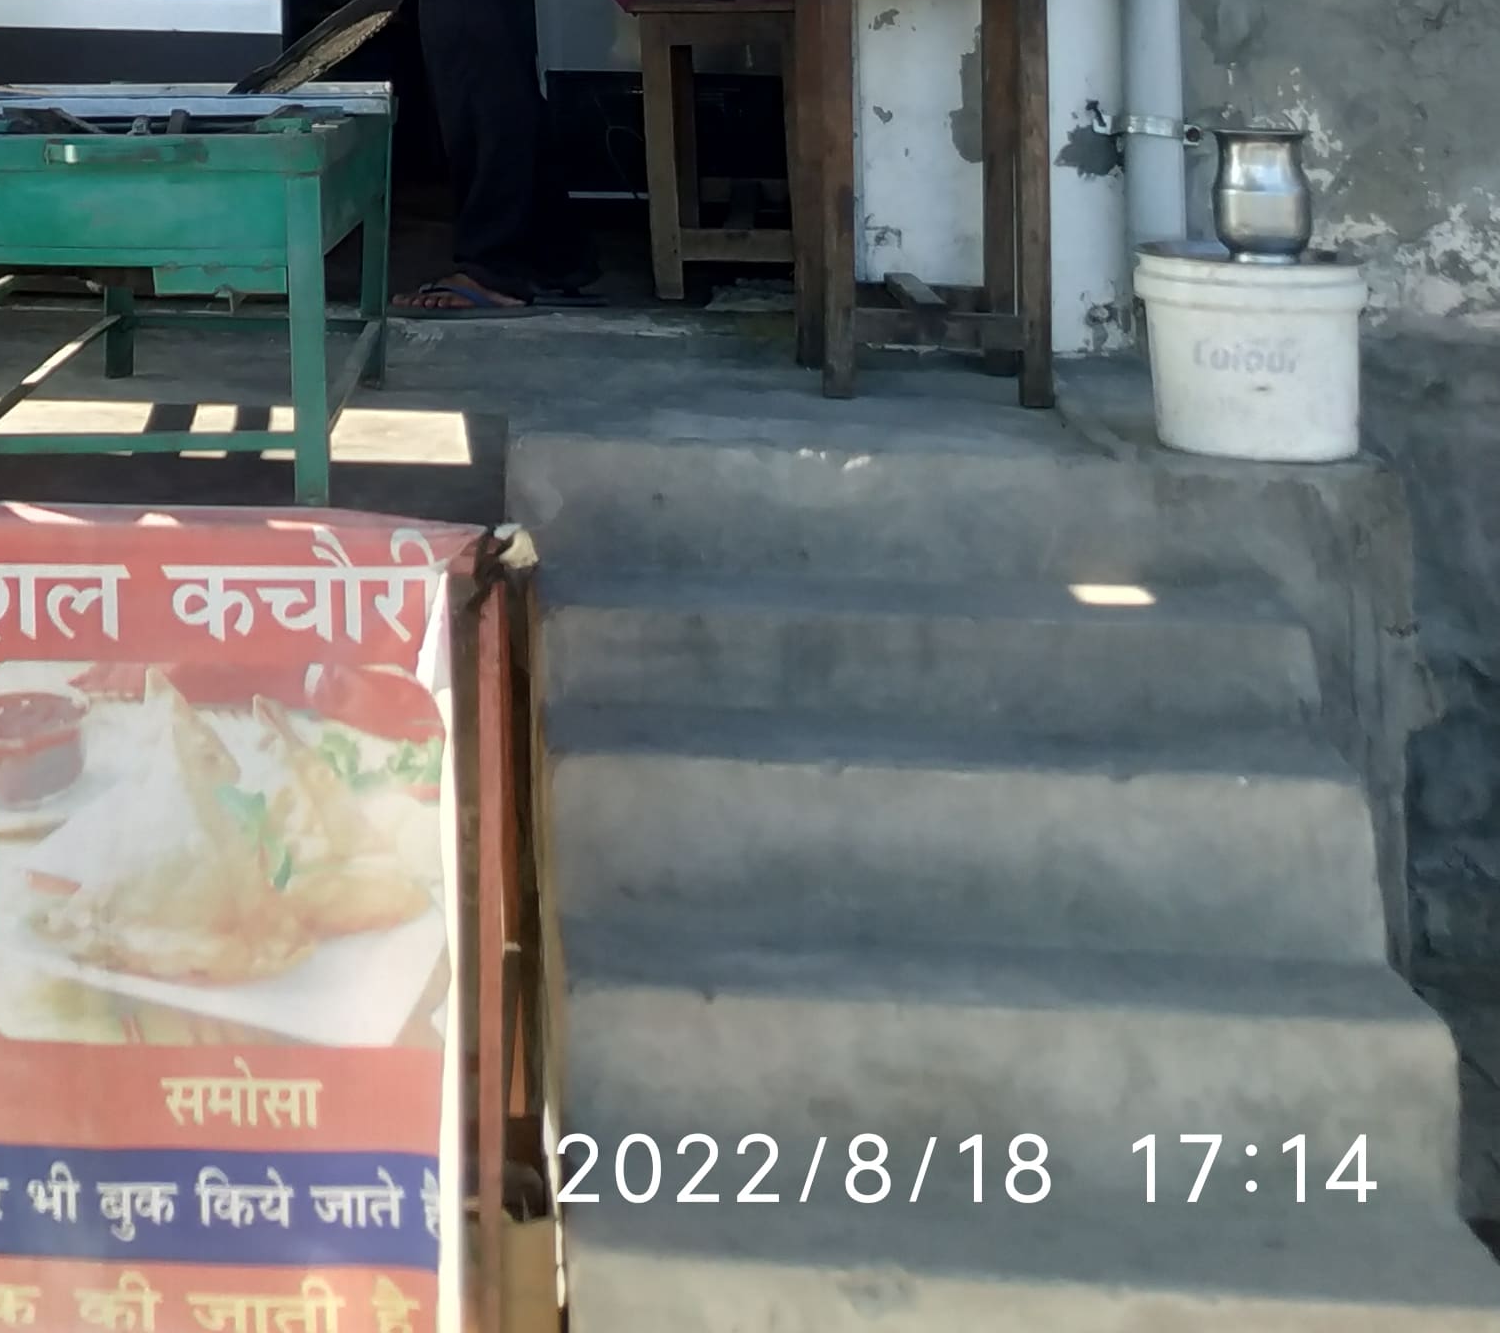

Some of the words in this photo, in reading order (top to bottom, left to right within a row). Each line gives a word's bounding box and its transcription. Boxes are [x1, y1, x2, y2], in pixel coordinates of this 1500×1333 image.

[161, 526, 448, 644] कचौरी
[160, 1056, 323, 1129] समोसा
[26, 1160, 81, 1223] भी
[97, 1181, 179, 1242] बुक
[195, 1166, 294, 1229] किये
[310, 1166, 405, 1230] जाते
[73, 1271, 162, 1333] की
[186, 1276, 346, 1333] जाती
